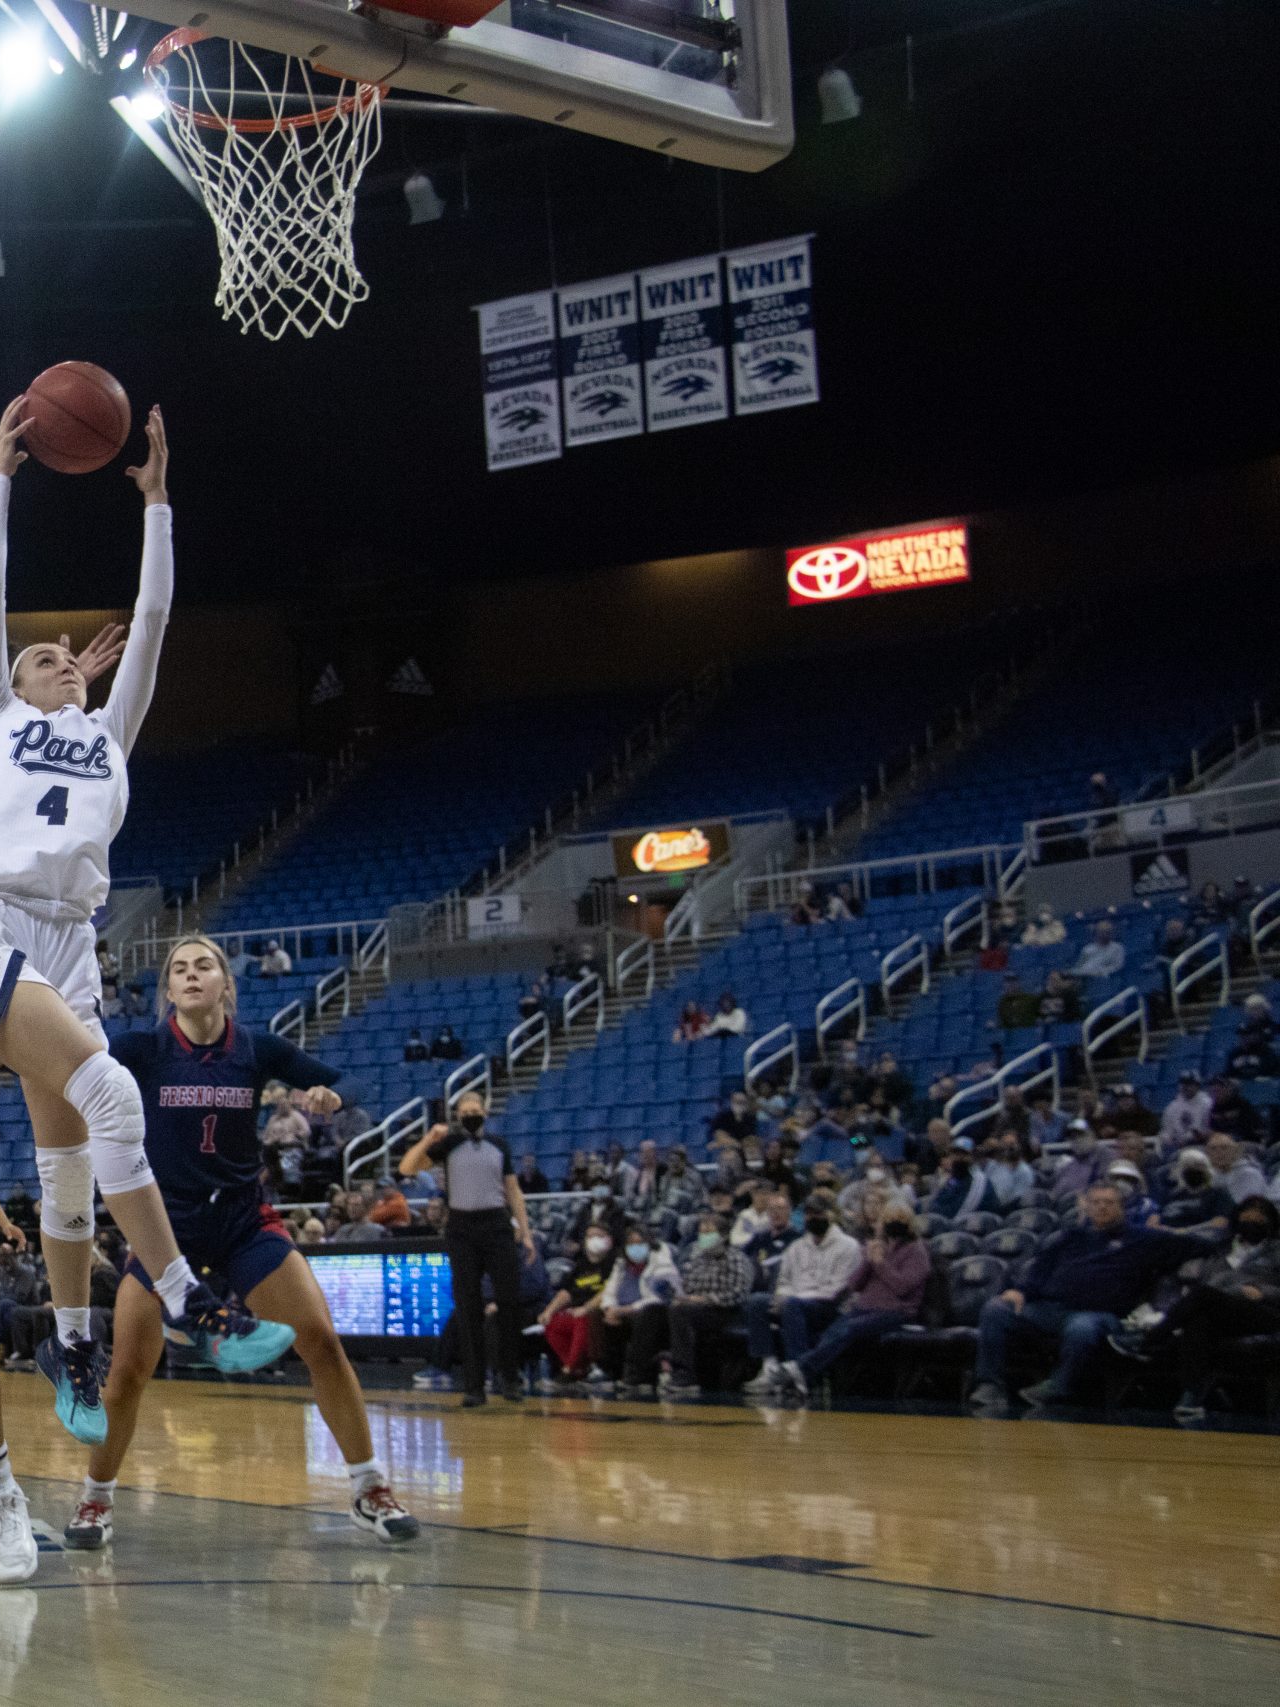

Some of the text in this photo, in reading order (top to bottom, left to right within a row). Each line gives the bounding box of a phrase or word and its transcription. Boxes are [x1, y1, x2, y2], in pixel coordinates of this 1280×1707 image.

[647, 272, 716, 309] WNIT
[733, 254, 805, 292] WNIT
[564, 290, 632, 326] WNIT
[734, 303, 810, 329] SECOND
[865, 528, 966, 557] NORTHERN
[867, 546, 967, 578] NEVADA
[9, 719, 114, 781] Pack
[35, 785, 70, 826] 4
[634, 827, 707, 873] Cane's
[159, 1086, 254, 1109] FRESNO STATE
[200, 1114, 218, 1153] 1
